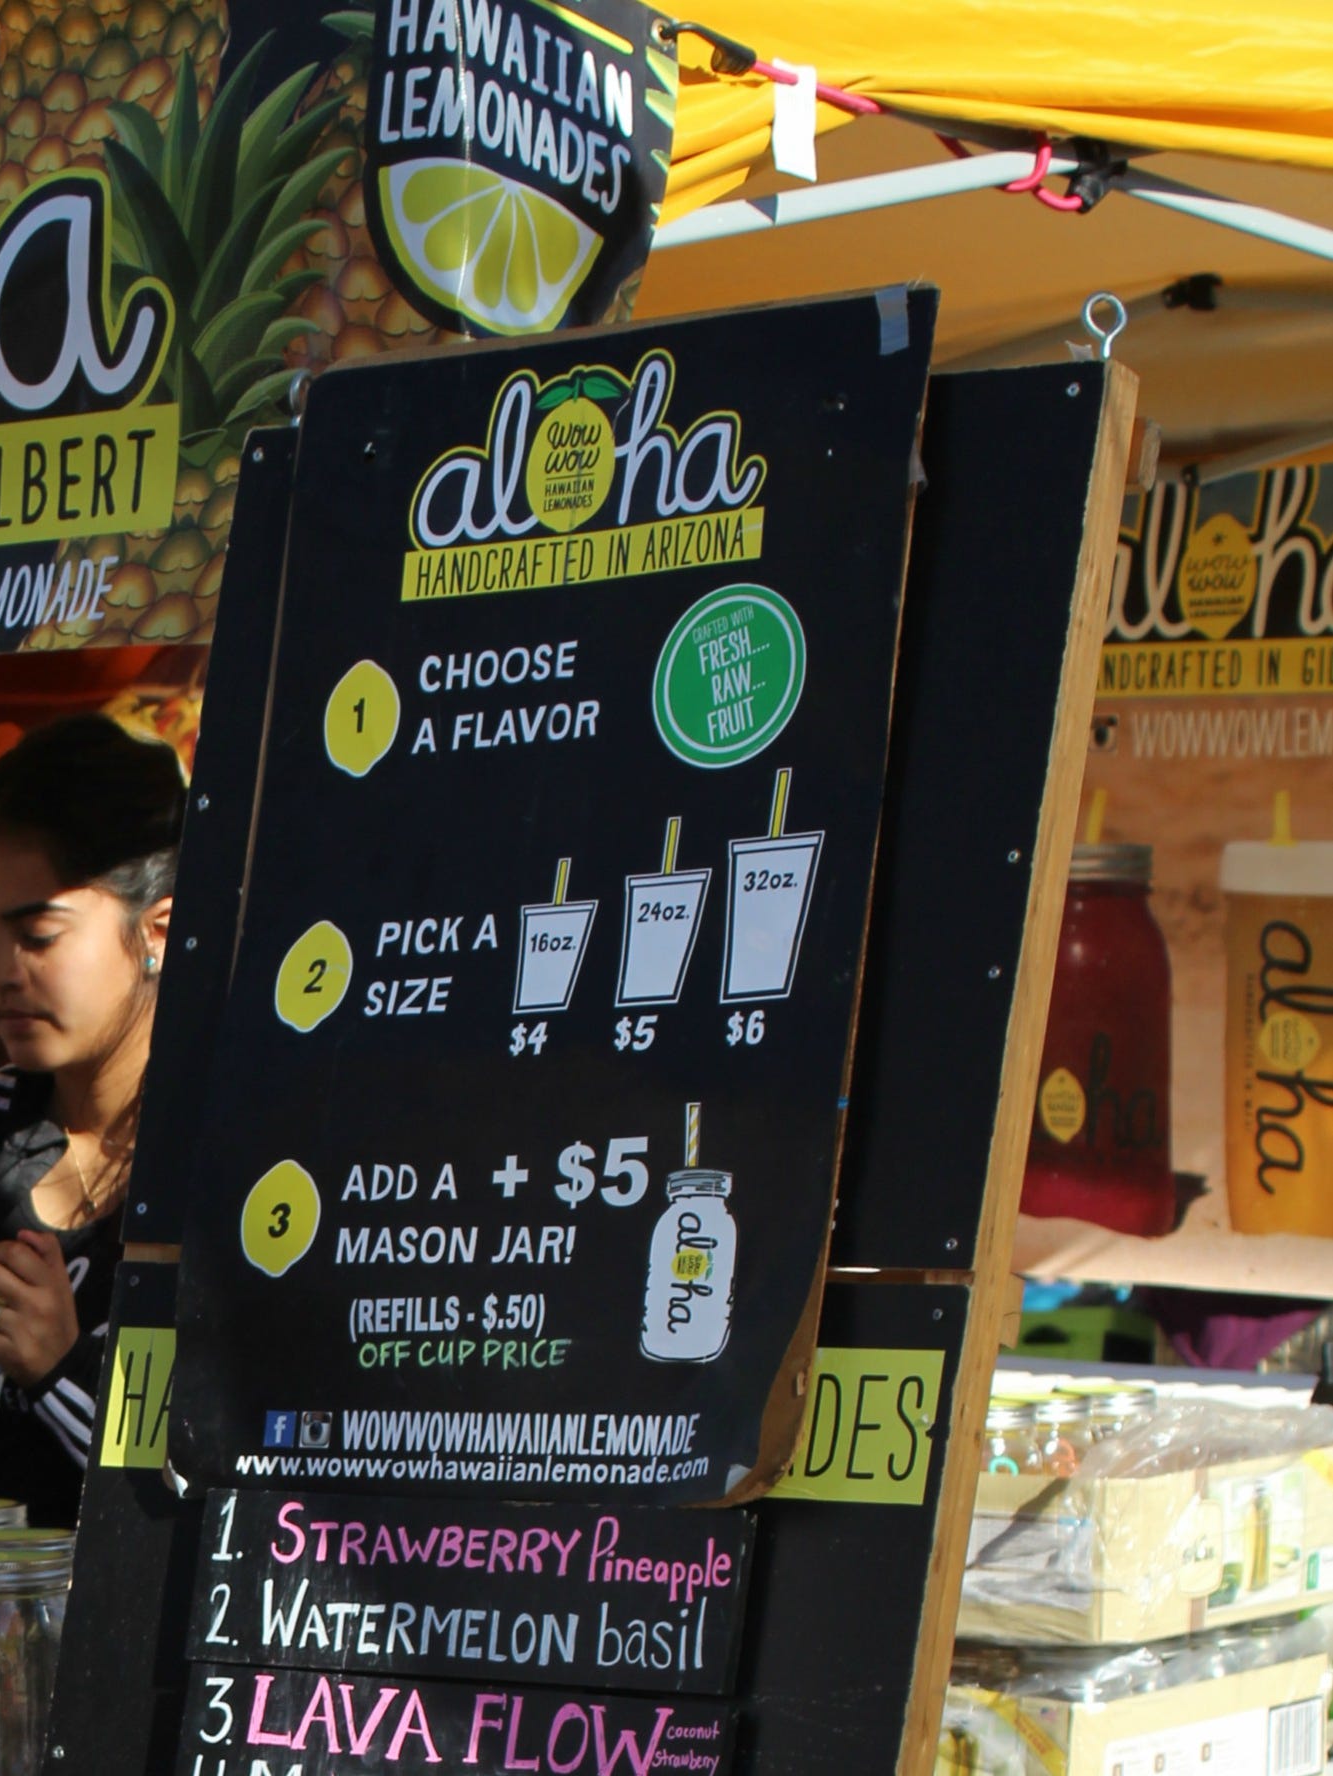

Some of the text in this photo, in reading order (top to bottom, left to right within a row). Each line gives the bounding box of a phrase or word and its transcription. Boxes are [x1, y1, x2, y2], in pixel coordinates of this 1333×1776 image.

[388, 0, 633, 138] HAWAIIAN
[379, 66, 631, 215] LEMONADES
[543, 494, 593, 513] LEMONADES
[545, 479, 595, 497] HAWAIIAN
[415, 520, 746, 598] HANDCRAFTED IN ARIZONA
[692, 604, 756, 645] CRAFTED WITH
[352, 640, 578, 733] 1 CHOOSE
[1257, 648, 1281, 687] IN
[411, 699, 601, 755] A FLAVOR
[706, 696, 755, 744] FRUIT
[742, 868, 799, 893] 32oz.
[529, 901, 691, 955] 16oz. 24oz.
[302, 913, 500, 995] 2 PICK A
[363, 975, 453, 1017] SIZE
[509, 1009, 766, 1057] $4 $5 $6
[340, 1163, 418, 1202] ADD
[431, 1162, 459, 1201] A
[553, 1135, 650, 1210] $5
[267, 1202, 578, 1264] 3 MASON JAR!
[348, 1295, 461, 1343] (REFILLS
[358, 1337, 573, 1371] OFF CUP PRICE
[342, 1409, 702, 1457] WOWWOWHAWAIIANLEMONADE
[235, 1453, 710, 1485] www.wowwowhawaiianlemonade.com
[209, 1495, 732, 1605] 1. STRAWBERRY Pineapple
[205, 1578, 708, 1672] 2. WATERMELON basil
[199, 1676, 234, 1747] 3.
[246, 1673, 442, 1764] LAVA
[666, 1719, 721, 1740] coconut
